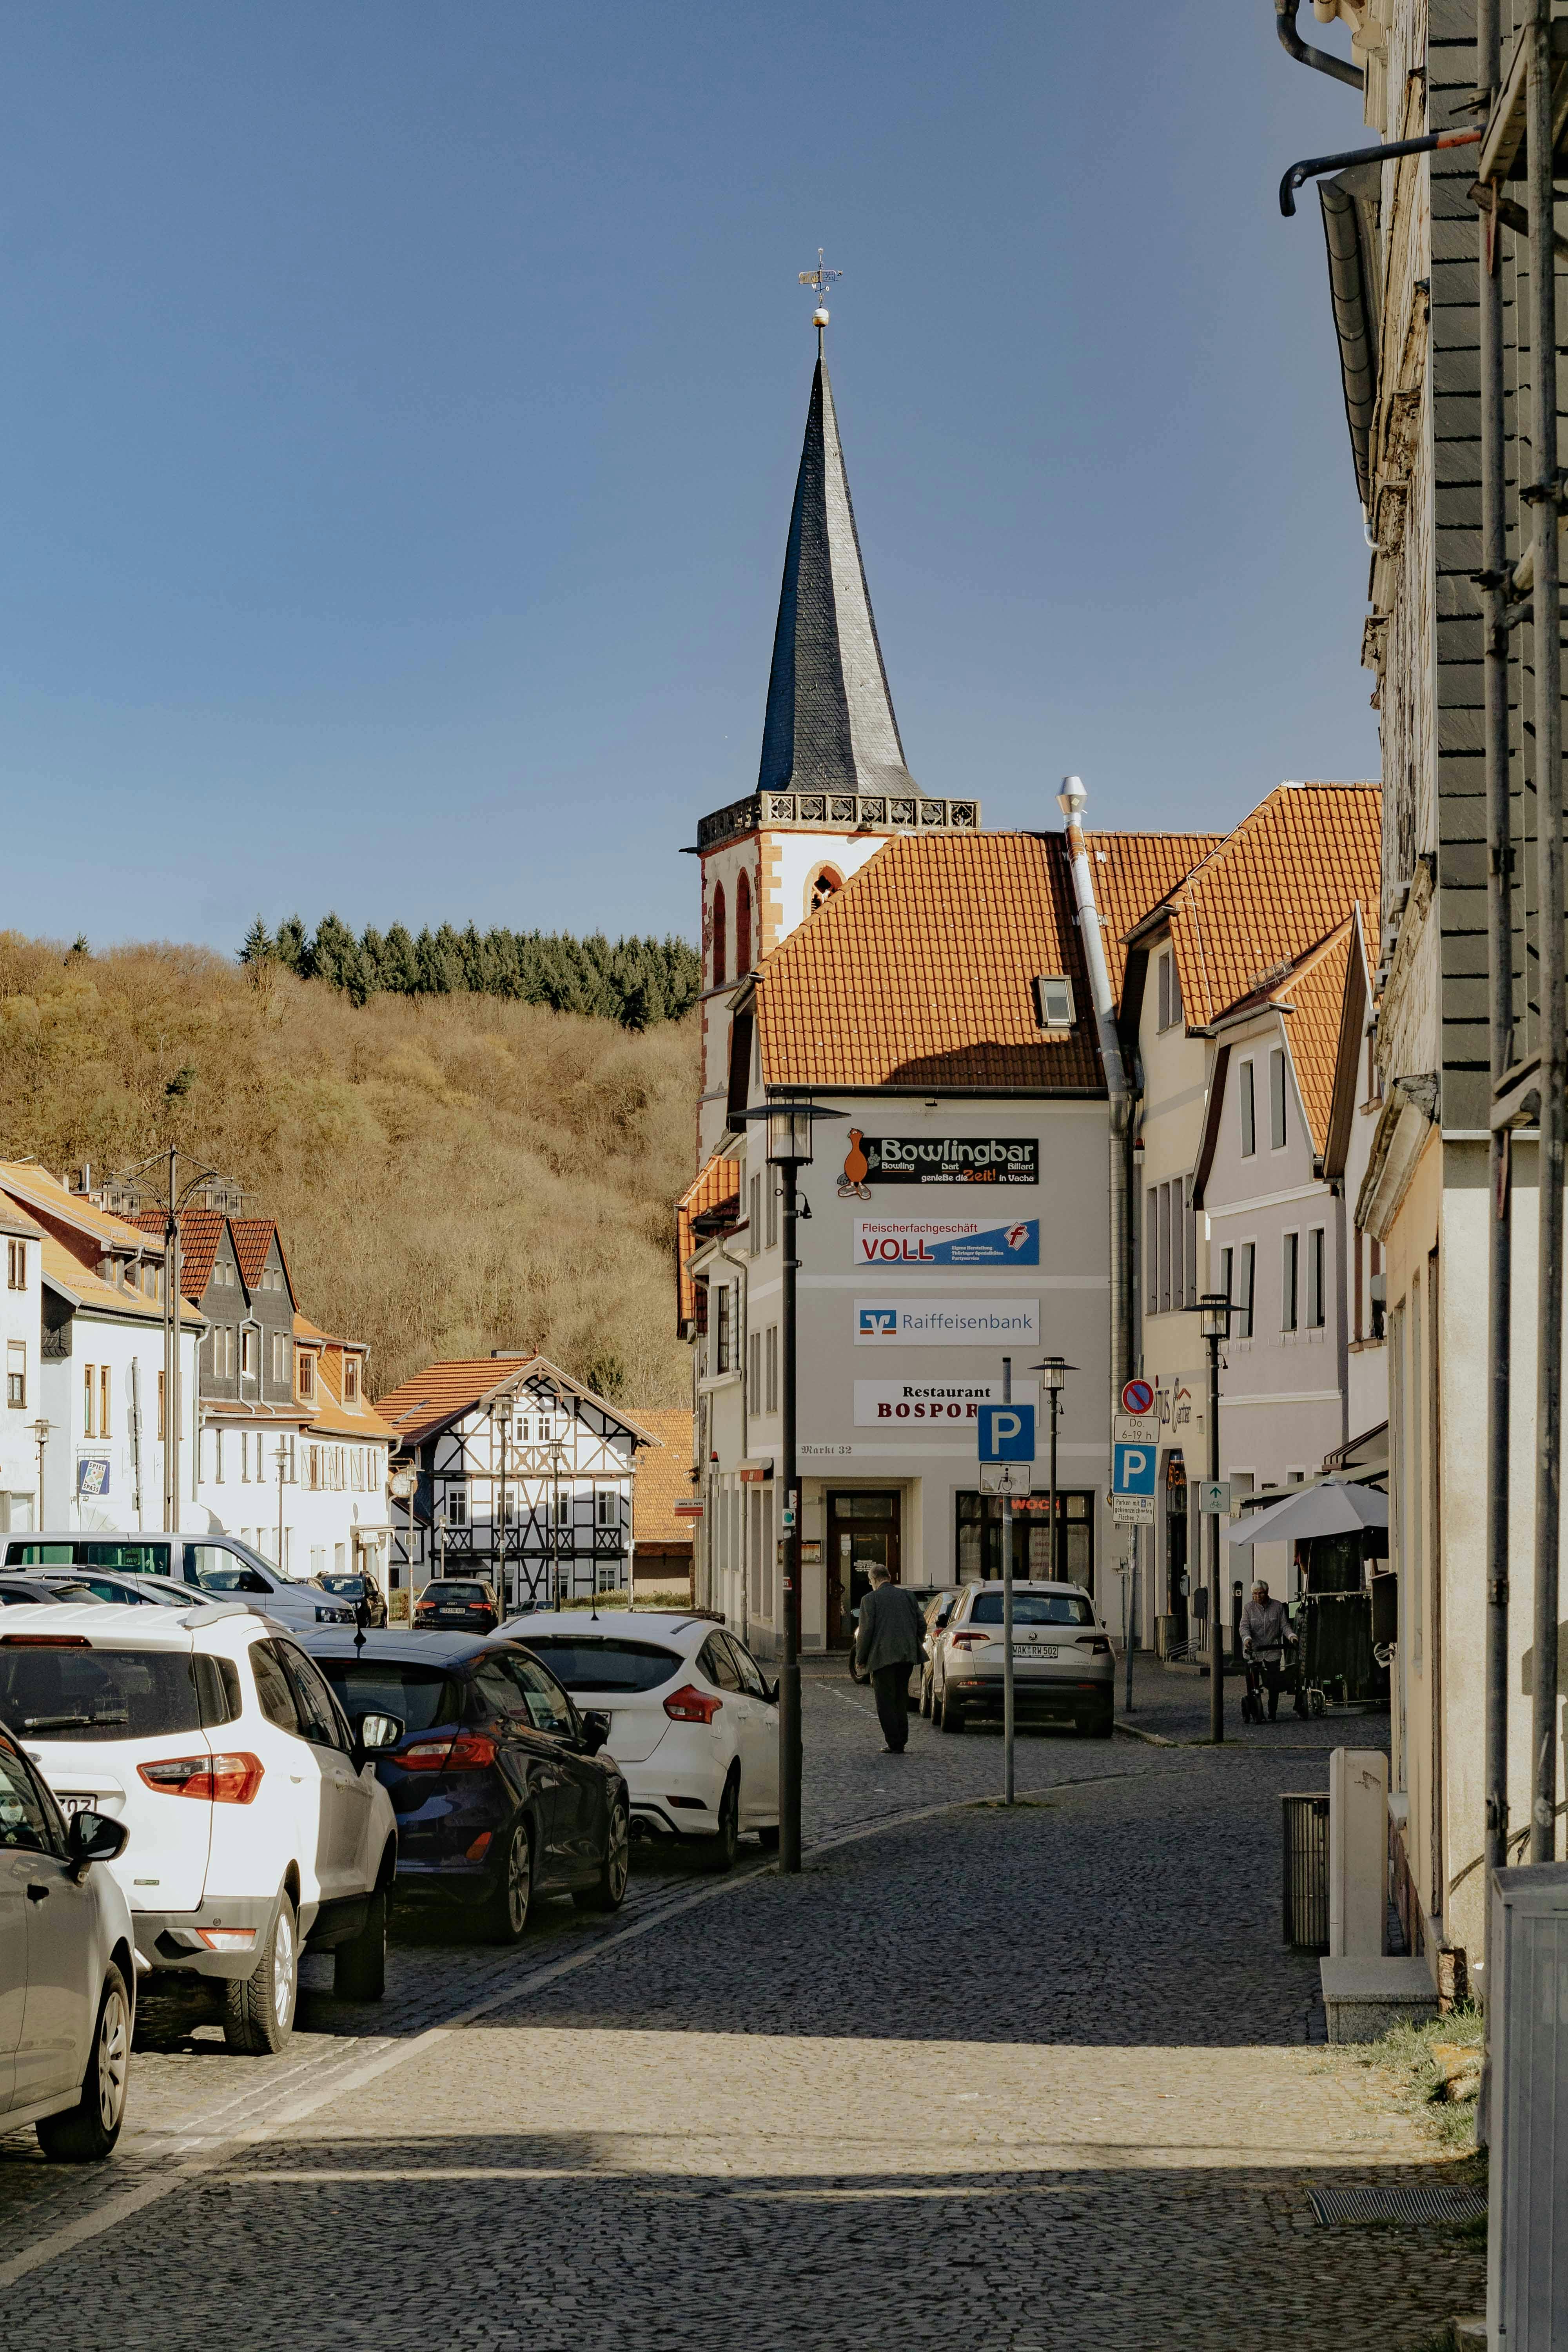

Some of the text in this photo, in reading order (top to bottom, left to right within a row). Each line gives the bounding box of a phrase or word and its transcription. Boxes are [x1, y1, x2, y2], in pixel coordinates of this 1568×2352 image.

[882, 1140, 1033, 1166] Bowlingbar
[882, 1162, 914, 1171] Bowling
[963, 1169, 996, 1181] Zeit!
[862, 1223, 978, 1234] Fleischerfachgeschäft
[862, 1239, 934, 1260] VOLL
[903, 1314, 1033, 1328] Raiffeisenbank
[903, 1387, 991, 1397] Restaurant
[878, 1403, 978, 1417] BOSPOR
[1130, 1418, 1144, 1427] Do.
[991, 1412, 1022, 1455] P
[1122, 1430, 1151, 1439] 6-19 h
[839, 1446, 852, 1454] 32
[89, 1463, 104, 1471] SPIEL
[1123, 1450, 1146, 1488] P
[83, 1484, 99, 1492] SPASS
